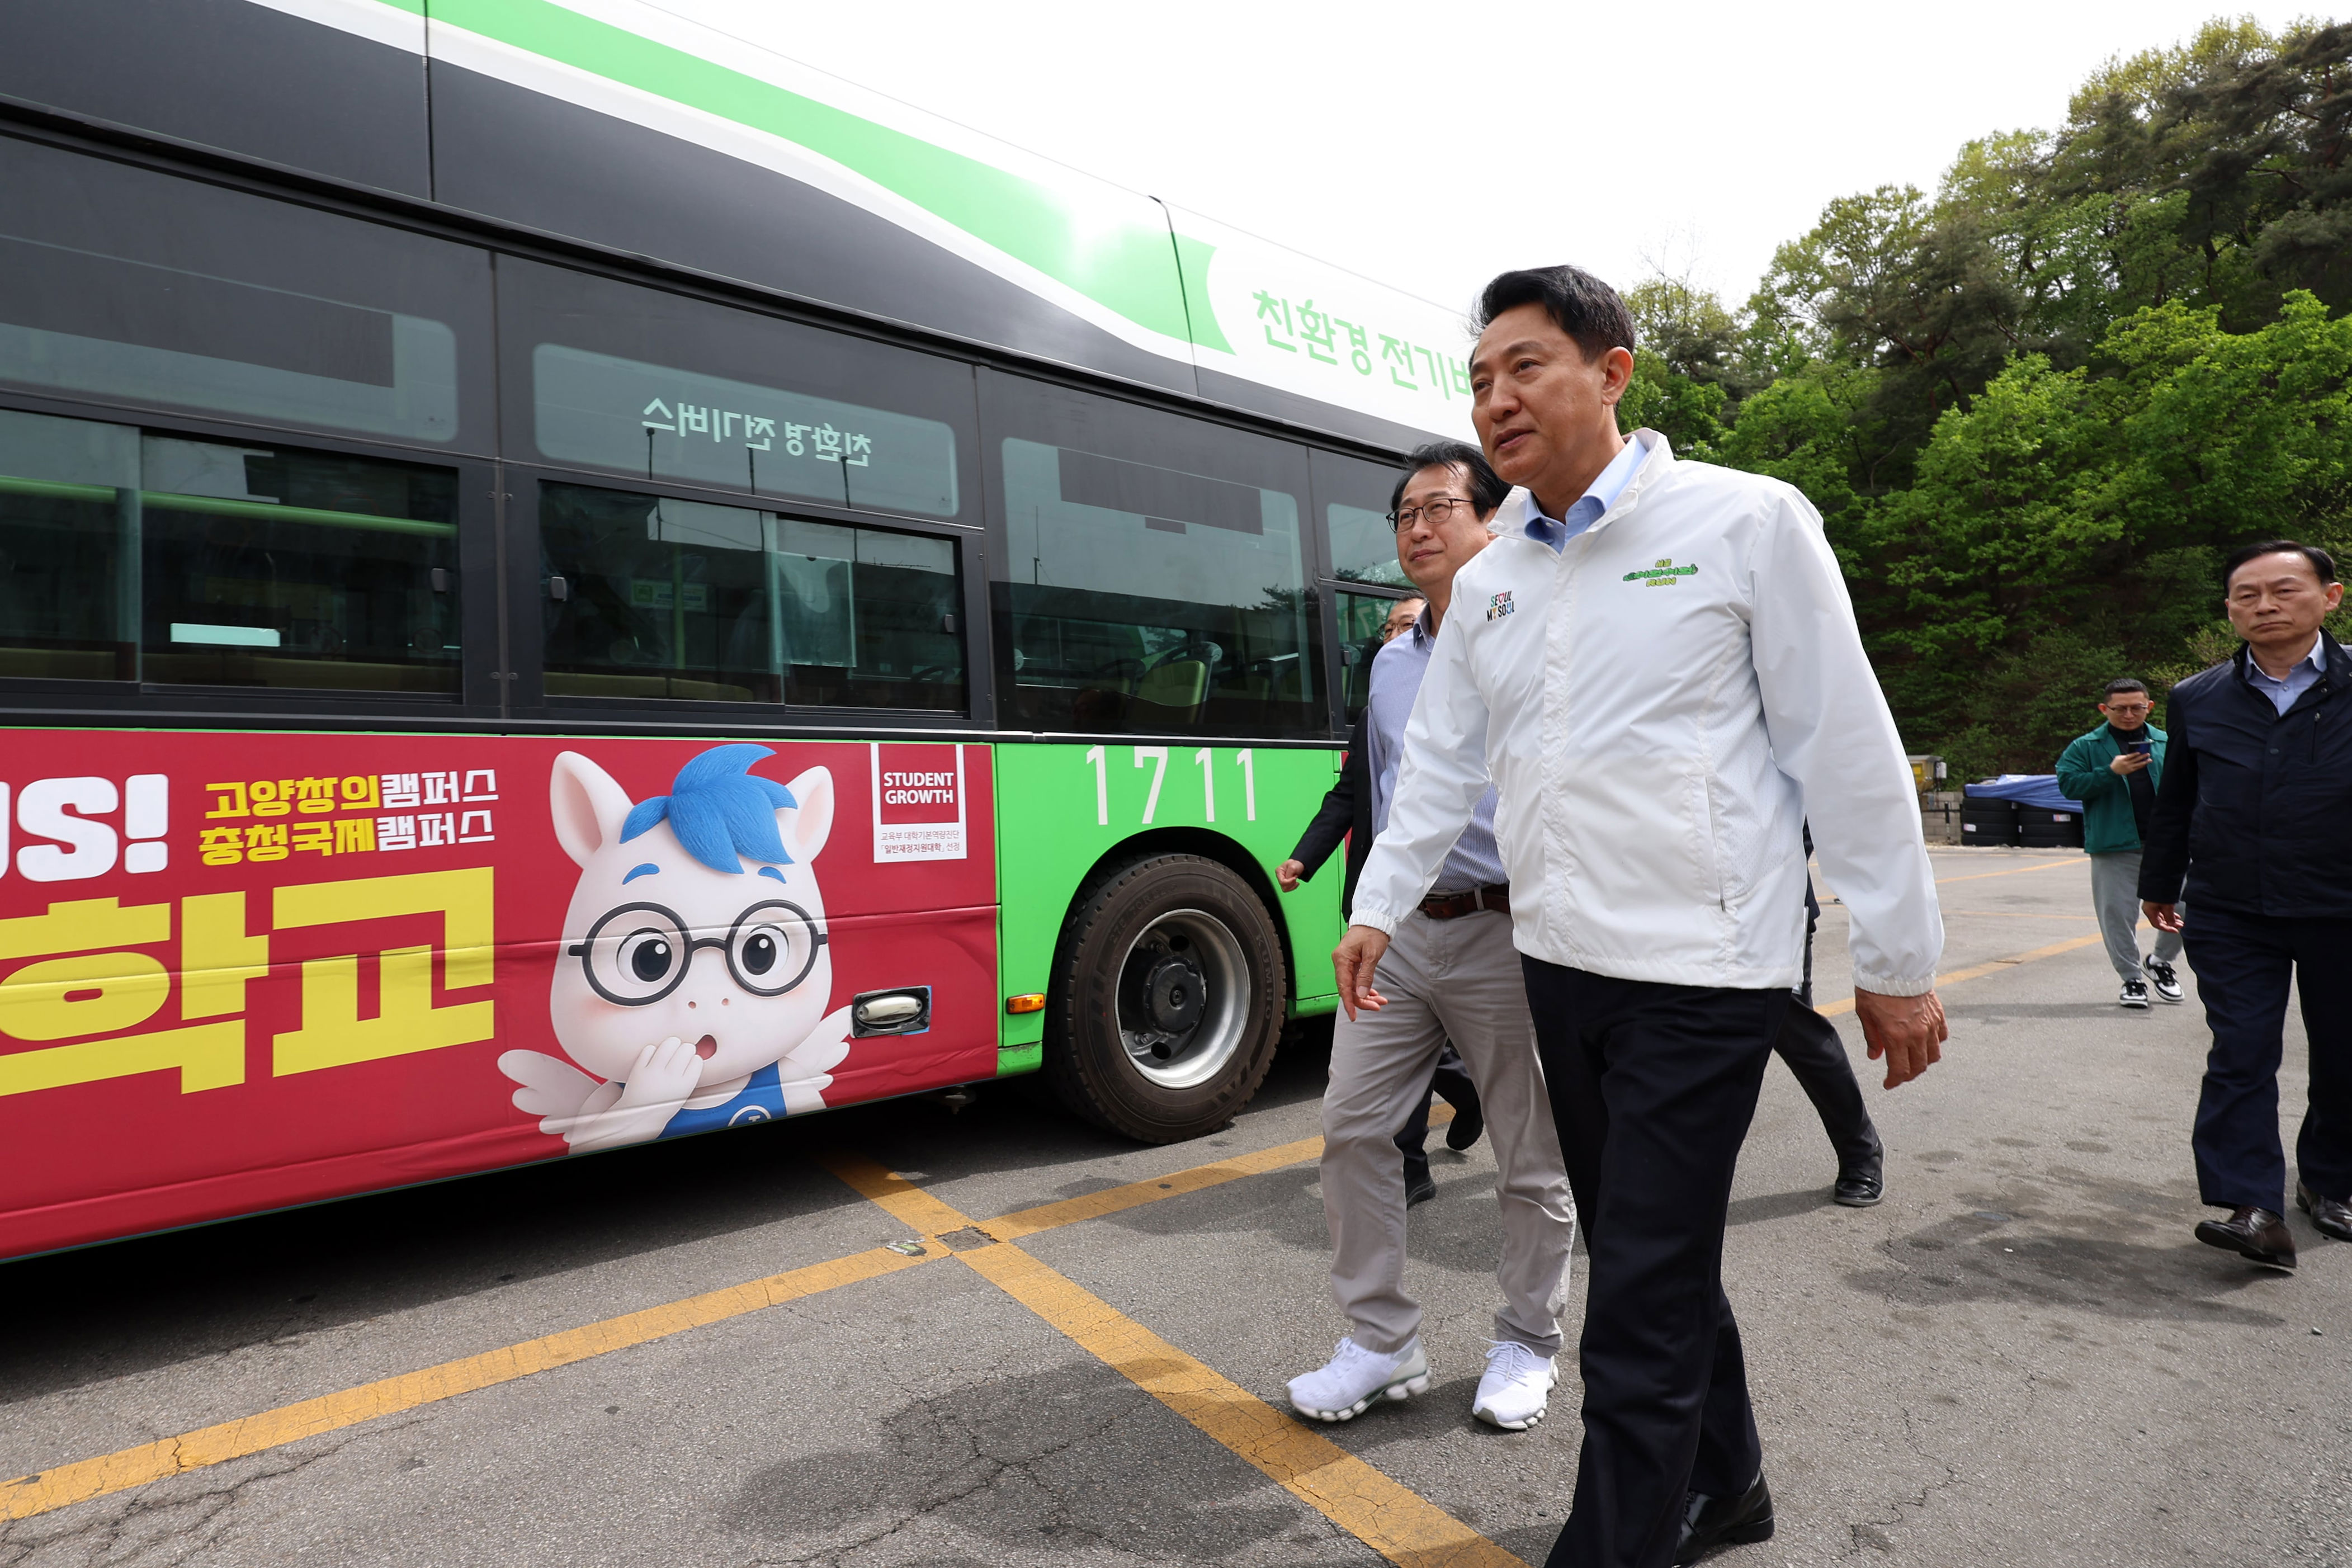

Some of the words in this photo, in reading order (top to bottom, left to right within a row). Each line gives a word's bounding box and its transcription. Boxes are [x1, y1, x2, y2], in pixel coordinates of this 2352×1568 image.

[1252, 289, 1372, 376] 친환경
[1646, 577, 1676, 587] RUN
[1498, 601, 1514, 617] SOUL
[205, 769, 499, 819] 고양창의캠퍼스
[883, 772, 954, 787] STUDENT
[1086, 745, 1256, 825] 1711
[885, 789, 953, 805] GROWTH
[199, 809, 495, 866] 충청국제캠퍼스
[881, 831, 903, 841] 교육부
[904, 830, 960, 840] 대학기본역량진단
[946, 842, 960, 852] 선정
[0, 866, 494, 1097] 학교
[1255, 934, 1273, 1021] KUMHO
